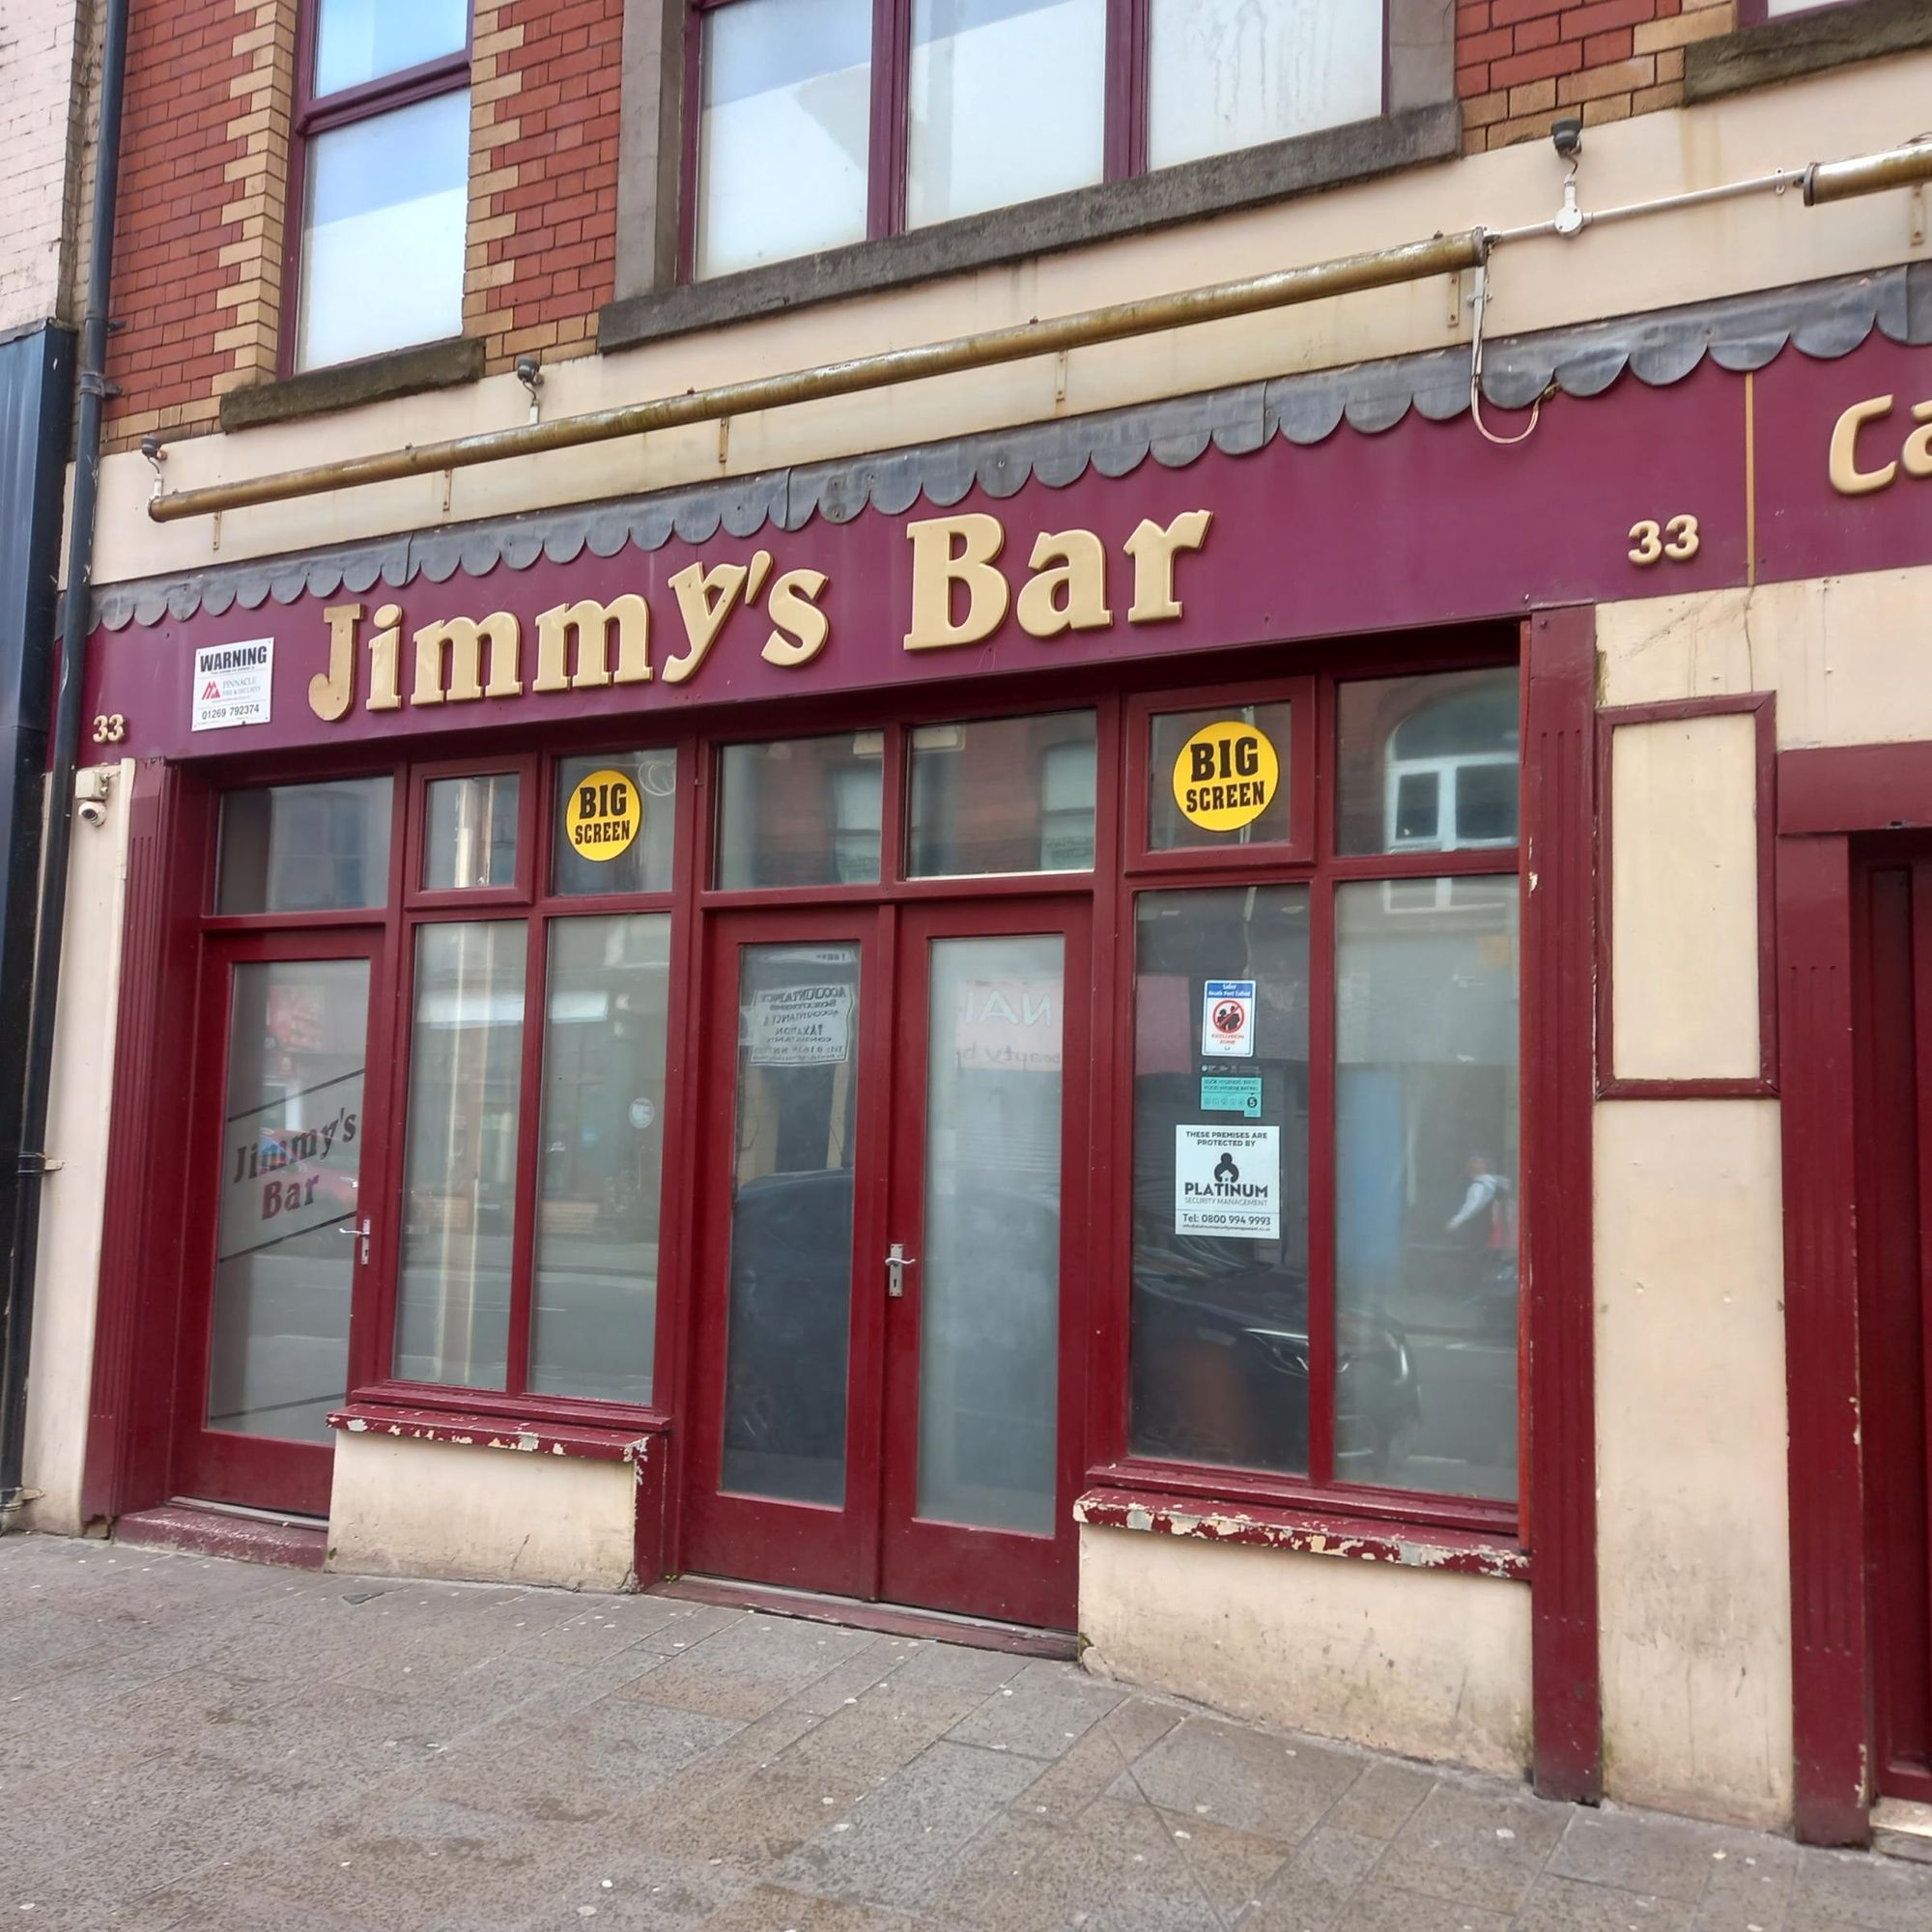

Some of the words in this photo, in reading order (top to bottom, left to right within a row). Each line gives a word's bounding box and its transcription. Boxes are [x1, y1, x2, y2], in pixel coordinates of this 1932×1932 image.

[1628, 514, 1700, 566] 33
[308, 550, 829, 722] Jimmy's
[903, 509, 1213, 651] Bar
[200, 645, 268, 673] WARNING
[202, 707, 226, 720] 01269
[230, 704, 260, 717] 792374
[93, 714, 125, 743] 33
[1190, 736, 1259, 782] BIG
[580, 782, 627, 819] BIG
[1186, 781, 1264, 812] SCREEN
[575, 820, 630, 845] SCREEN
[233, 1107, 356, 1183] Jimmy's
[262, 1174, 320, 1220] Bar
[1184, 1181, 1268, 1198] PLATINUM
[1217, 1198, 1267, 1207] MANAGEMENT
[1182, 1213, 1200, 1223] Tel:
[1201, 1214, 1227, 1224] 0800
[1228, 1215, 1246, 1225] 994
[1248, 1216, 1271, 1226] 9993
